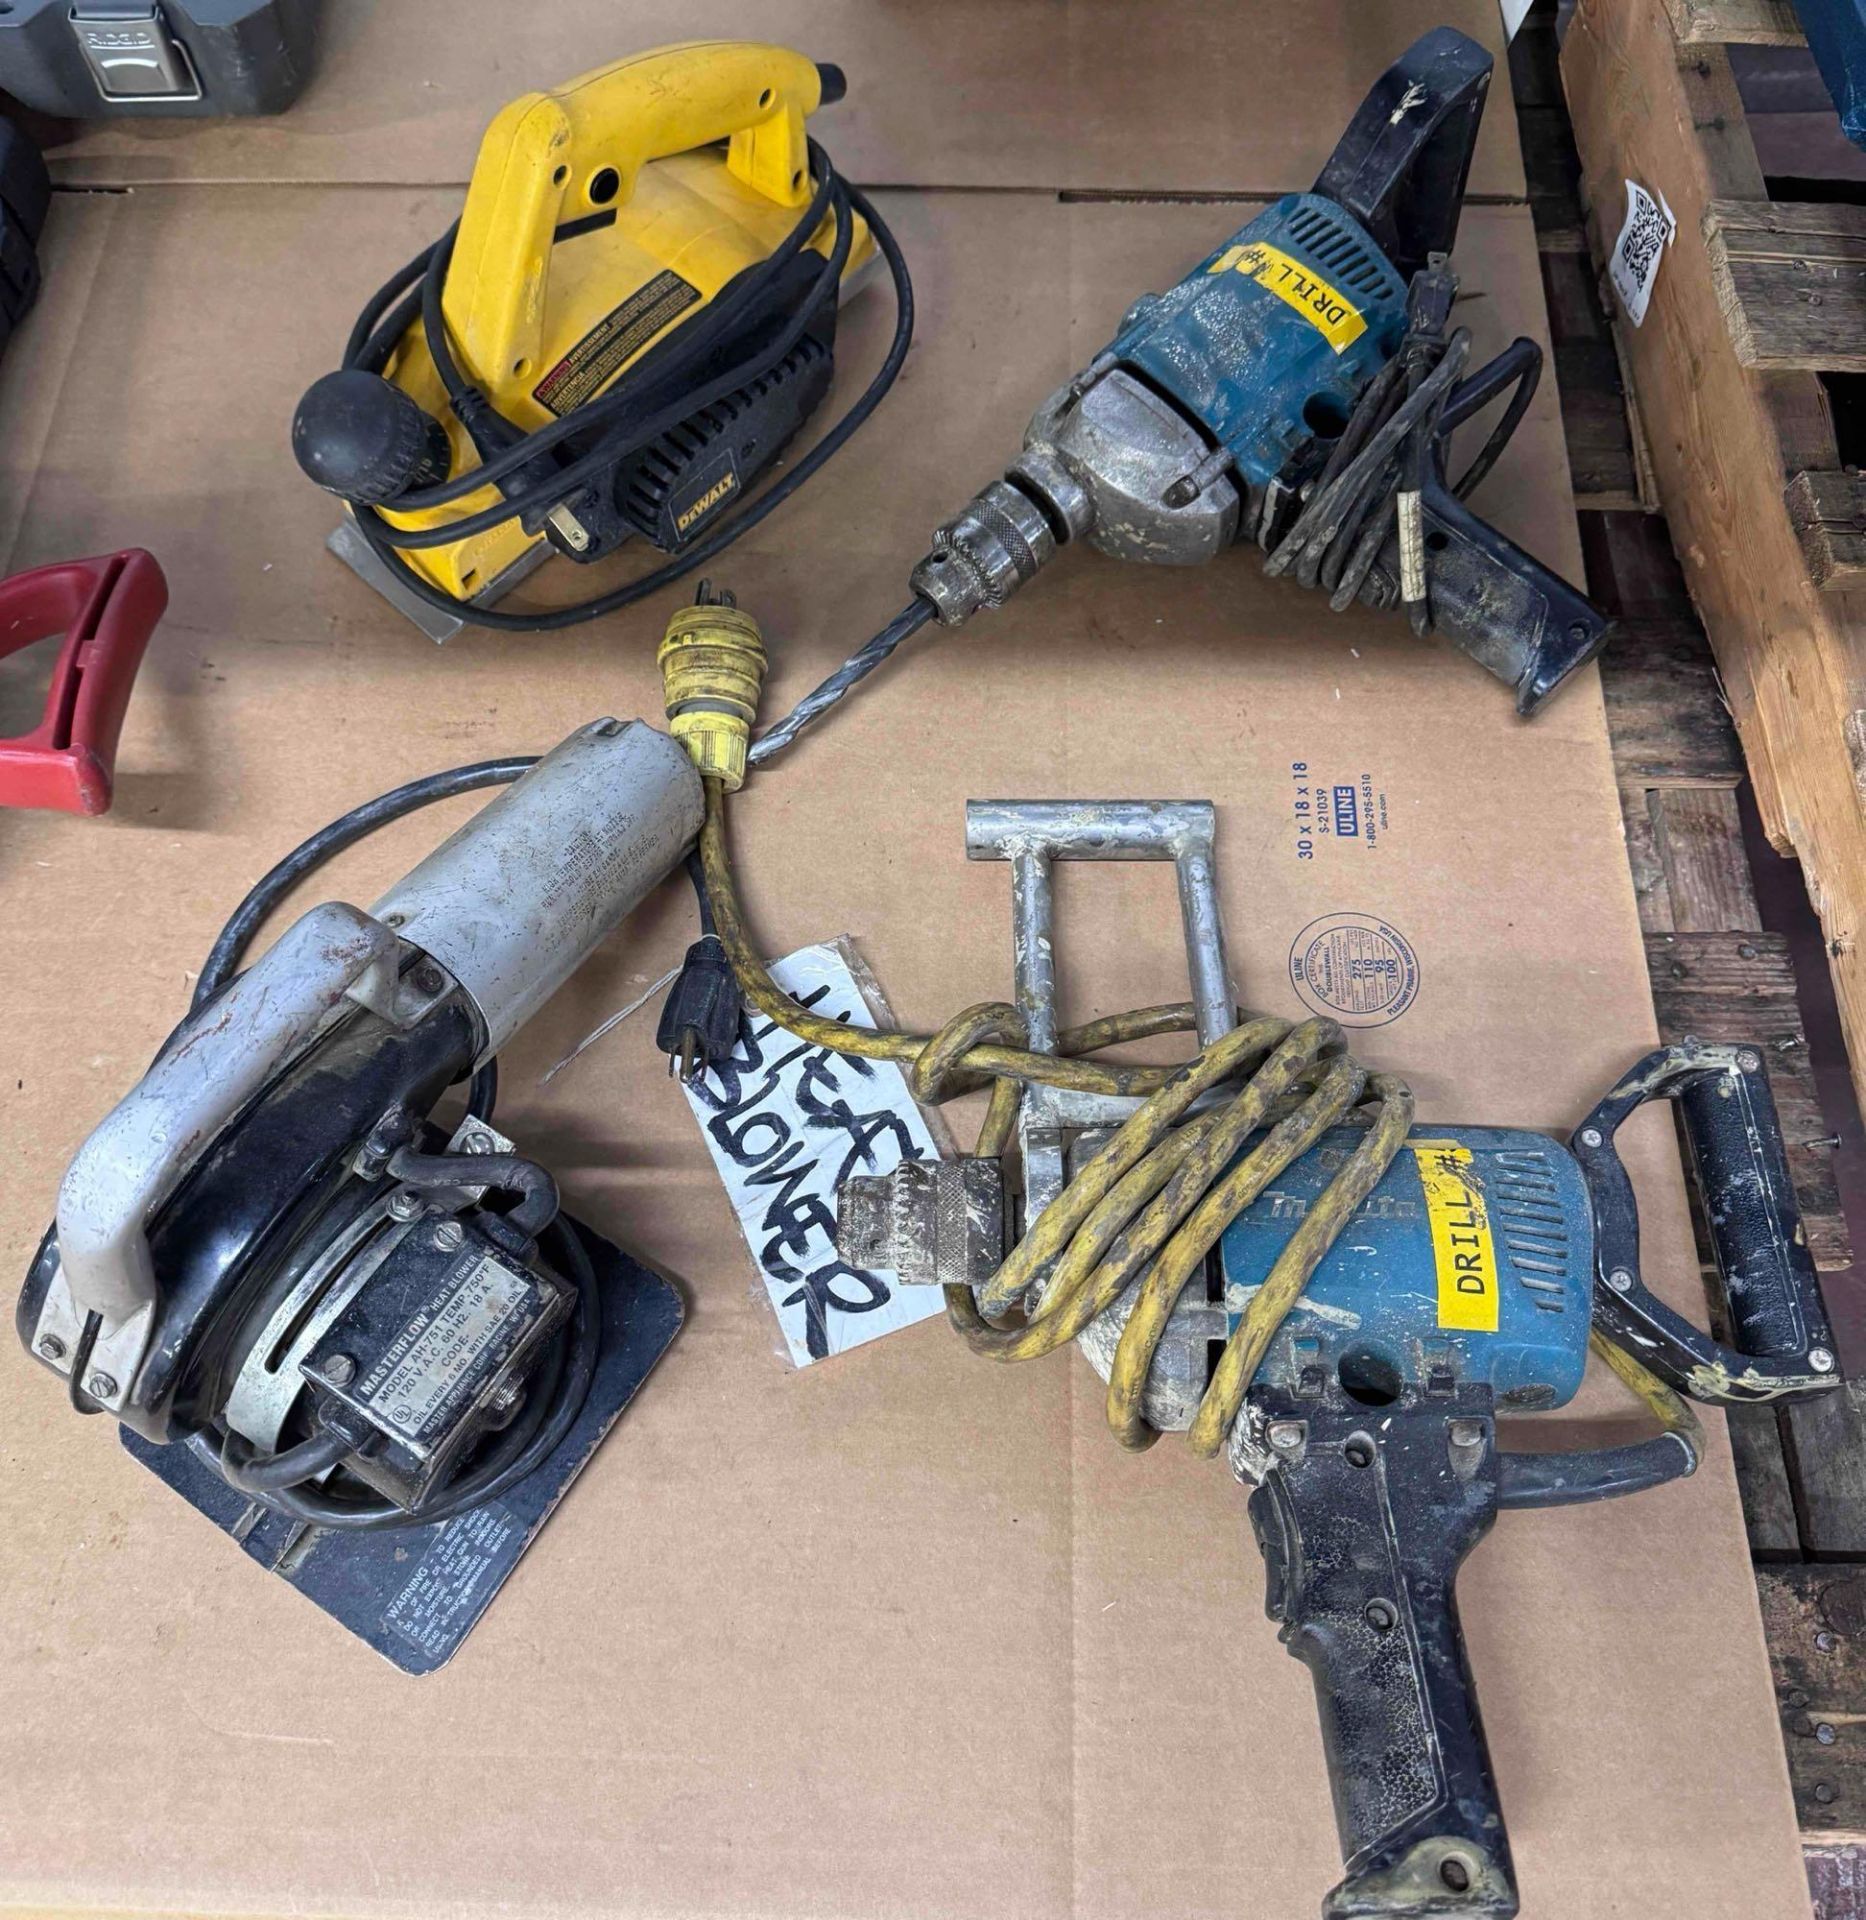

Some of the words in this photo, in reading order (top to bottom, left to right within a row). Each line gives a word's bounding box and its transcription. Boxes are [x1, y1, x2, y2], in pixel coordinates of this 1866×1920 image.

[1275, 262, 1347, 327] DRILL
[1291, 761, 1308, 780] 18
[1296, 786, 1309, 796] x
[1294, 800, 1310, 819] 18
[1299, 824, 1312, 835] x
[1314, 787, 1330, 834] S-21039
[1336, 787, 1355, 834] ULINE
[1360, 773, 1377, 850] 1-800-295-5510
[1377, 792, 1388, 830] uline.com
[1296, 838, 1314, 860] 30
[1292, 955, 1305, 981] ULINE
[1308, 939, 1325, 982] CERTIFICATE
[1350, 958, 1362, 980] 275
[1362, 957, 1374, 979] 110
[1374, 958, 1385, 973] 95
[1385, 958, 1397, 979] 100
[686, 1007, 889, 1362] BLOWER
[1444, 1190, 1484, 1295] DRILL
[428, 1286, 452, 1312] HEAT
[447, 1252, 479, 1290] BLOWER
[378, 1360, 414, 1404] MODEL
[408, 1323, 445, 1364] AH-751
[396, 1376, 418, 1400] 120
[439, 1326, 457, 1345] 60
[467, 1292, 484, 1309] 18
[411, 1406, 430, 1426] OIL
[424, 1378, 452, 1410] EVERY
[466, 1331, 489, 1356] WITH
[483, 1313, 503, 1334] SAE
[497, 1301, 511, 1316] 20
[506, 1286, 523, 1304] OIL
[422, 1404, 448, 1435] MASTER
[440, 1531, 466, 1563] ELECTRIC
[385, 1565, 430, 1620] WARNING
[434, 1542, 446, 1555] TO
[402, 1618, 414, 1632] DO
[410, 1602, 426, 1619] NOT
[441, 1556, 458, 1576] HEAT
[455, 1539, 470, 1556] GUN
[467, 1527, 478, 1539] TO
[475, 1510, 491, 1527] RAIN
[416, 1611, 442, 1643] CONNECT
[442, 1593, 454, 1606] TO
[453, 1553, 483, 1589] GROUNDED
